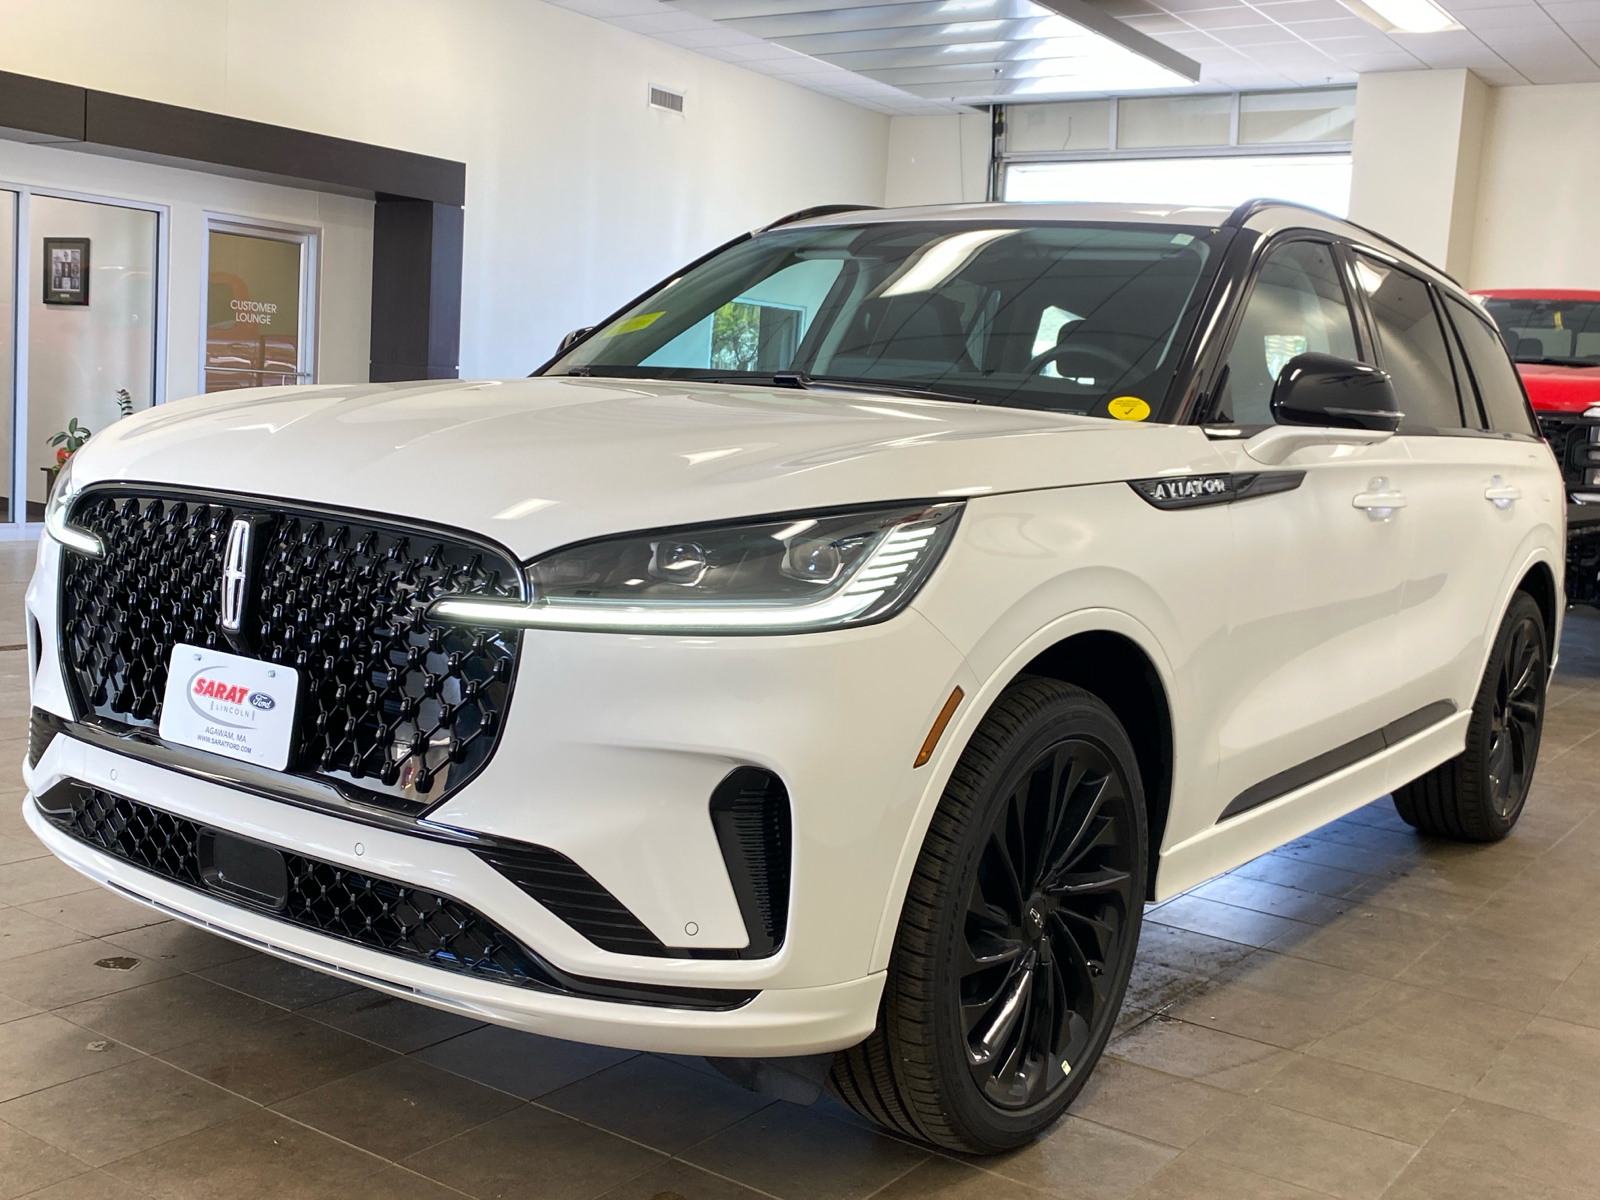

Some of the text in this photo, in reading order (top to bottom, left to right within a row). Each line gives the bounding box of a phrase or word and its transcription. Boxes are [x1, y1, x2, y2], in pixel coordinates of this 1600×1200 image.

[230, 299, 277, 313] CUSTOMER
[235, 312, 271, 325] LOUNGE
[1154, 479, 1226, 498] AVIATOR
[193, 678, 249, 704] SARAT
[253, 694, 272, 709] Ford
[215, 703, 250, 718] LINCOLN
[205, 726, 247, 743] AGAWAM, MA
[197, 734, 252, 754] WWW.SARATFORD.COM
